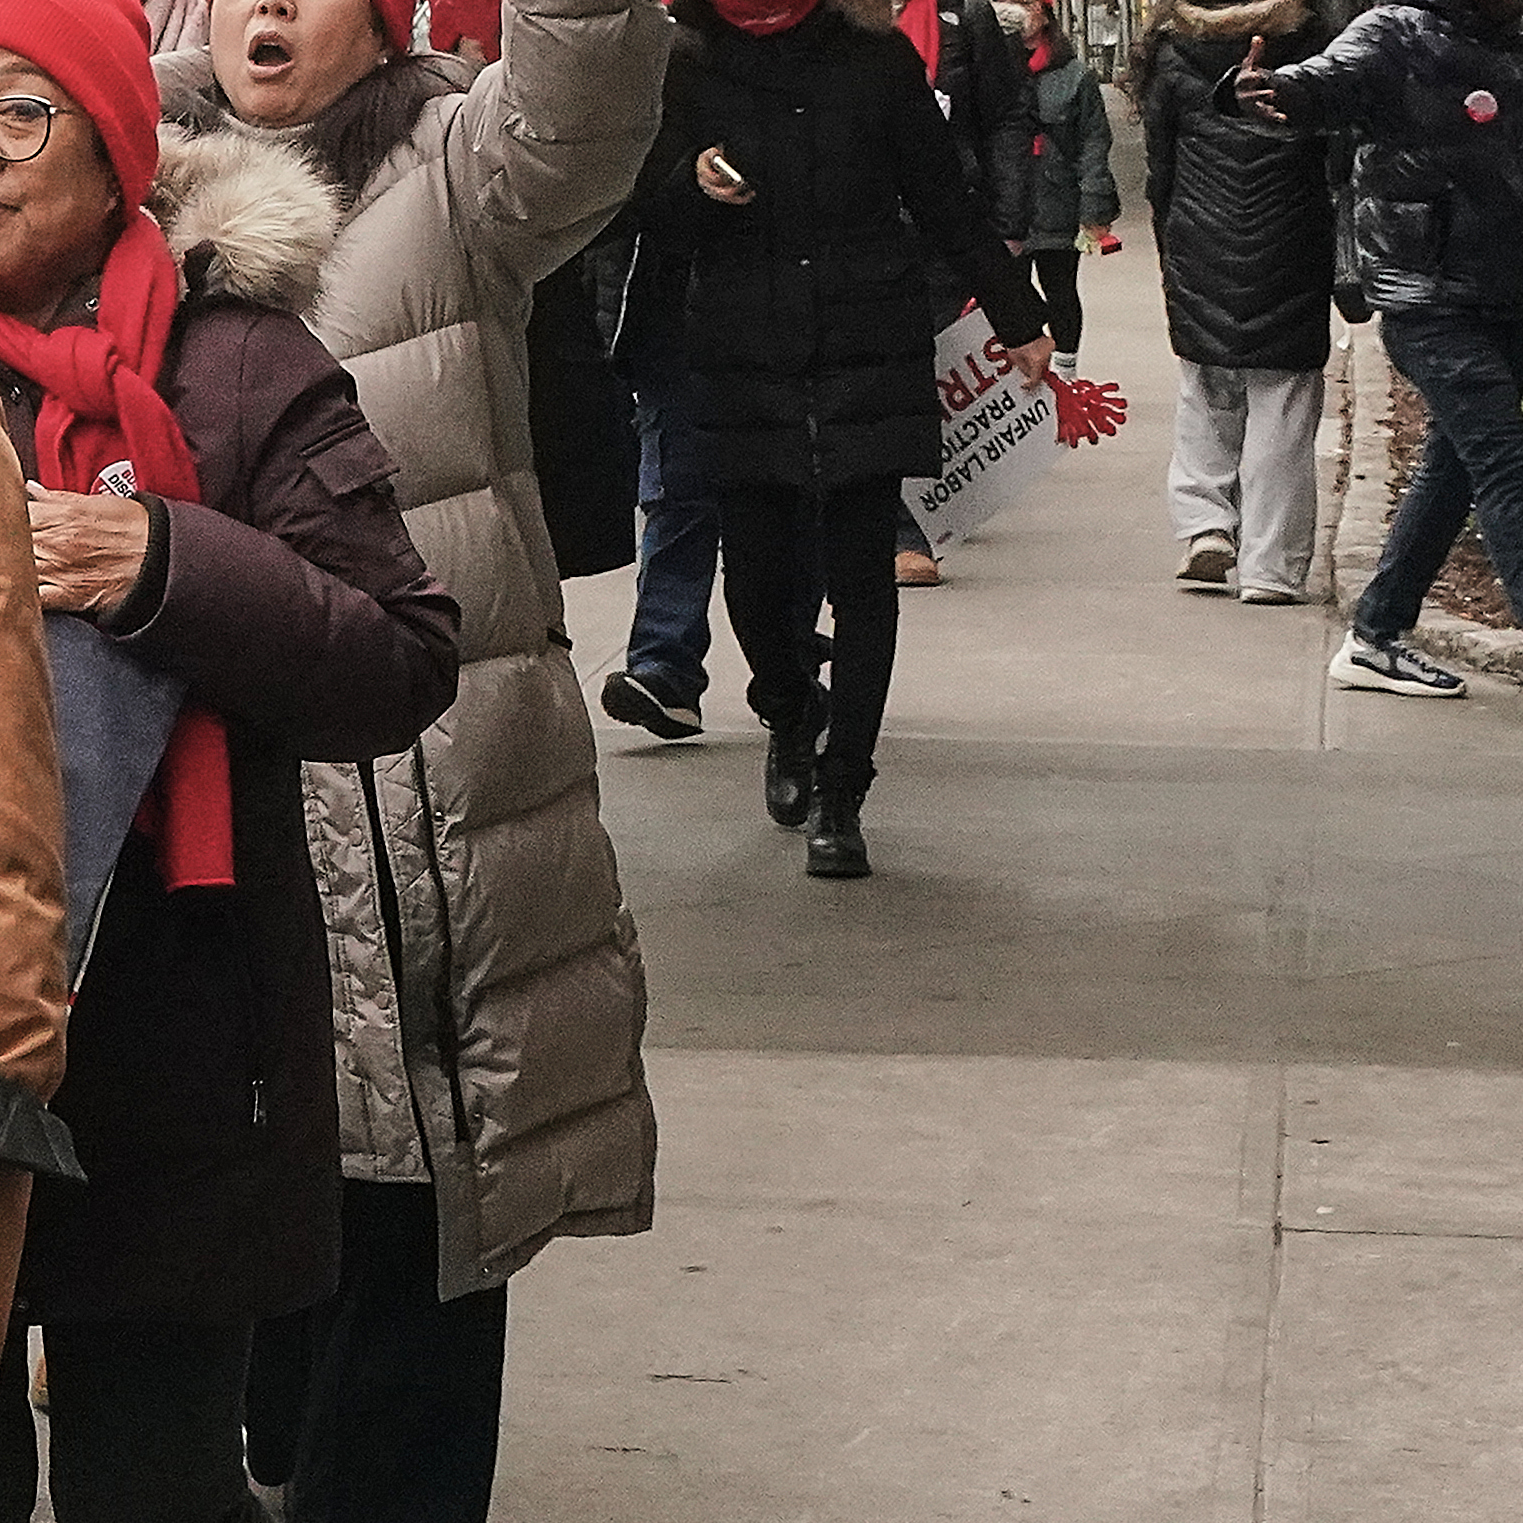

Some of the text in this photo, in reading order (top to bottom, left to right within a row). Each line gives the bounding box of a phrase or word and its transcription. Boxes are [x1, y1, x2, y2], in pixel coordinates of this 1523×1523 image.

[937, 335, 1013, 423] STR
[919, 398, 1051, 513] UNFAIR LABOR
